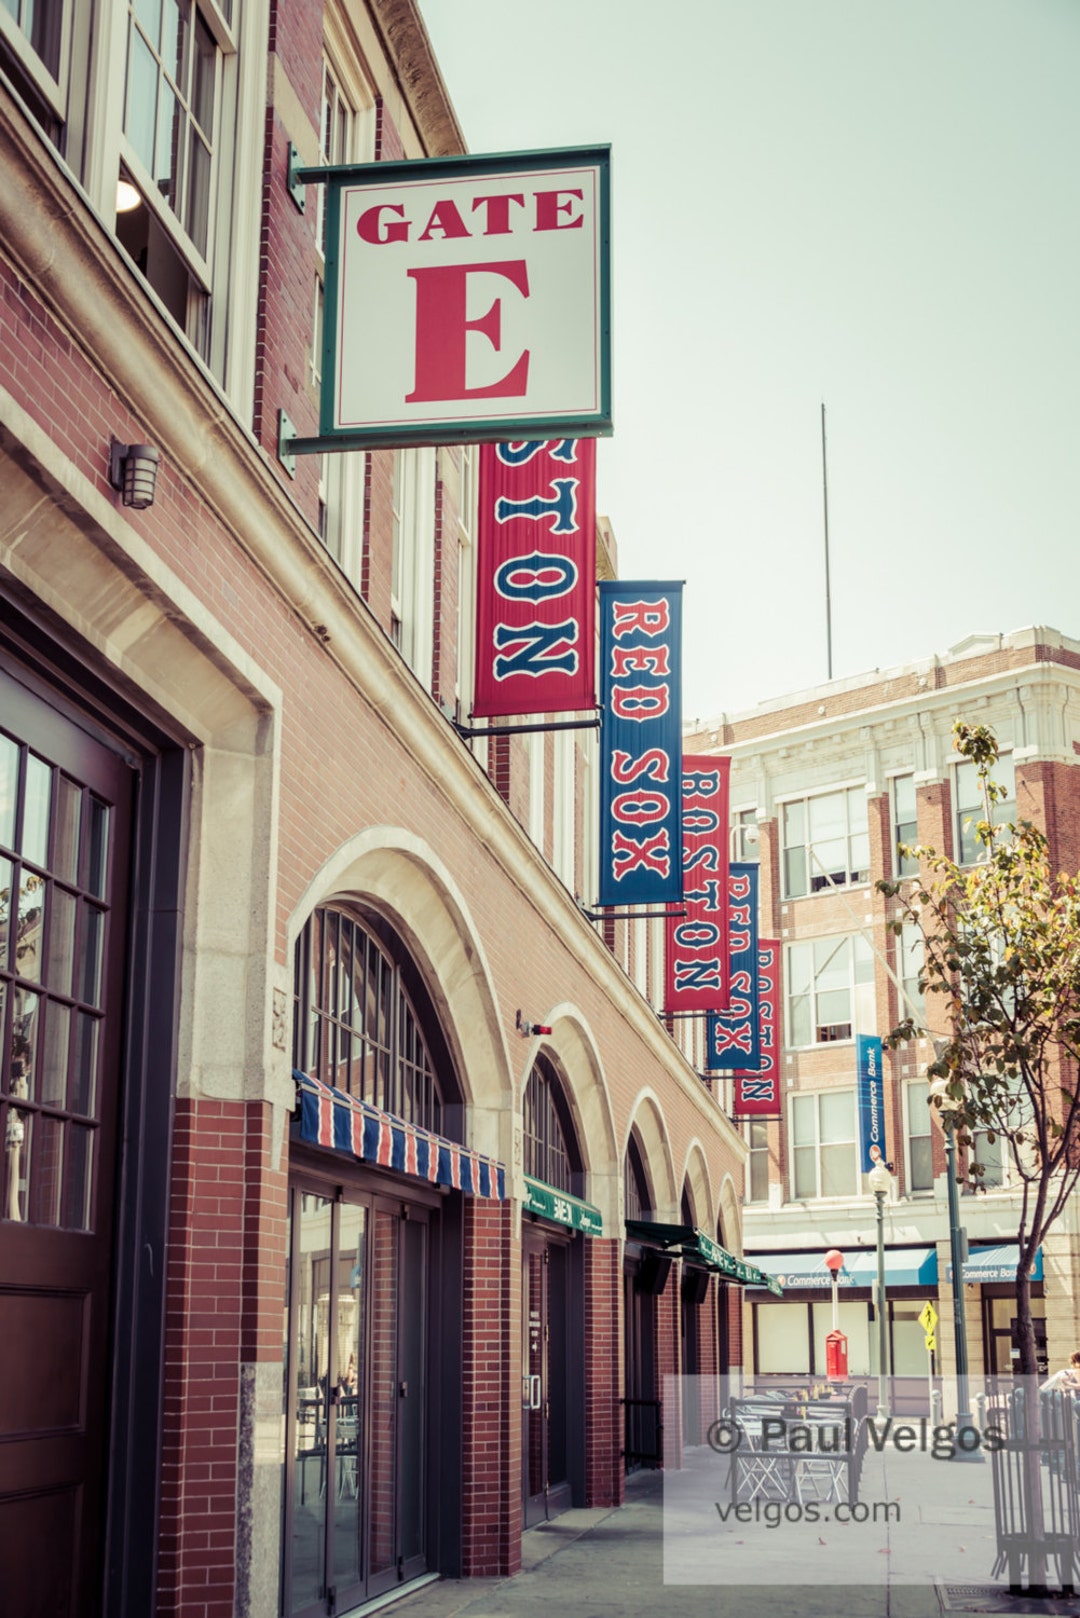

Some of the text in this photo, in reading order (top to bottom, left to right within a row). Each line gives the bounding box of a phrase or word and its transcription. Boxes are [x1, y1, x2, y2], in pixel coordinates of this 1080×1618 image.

[356, 188, 584, 245] GATE
[405, 259, 530, 403] E
[609, 597, 671, 882] RED SOX
[674, 769, 722, 992] BOSTON
[867, 1046, 879, 1143] Commerce Bank
[787, 1274, 831, 1286] Commerce
